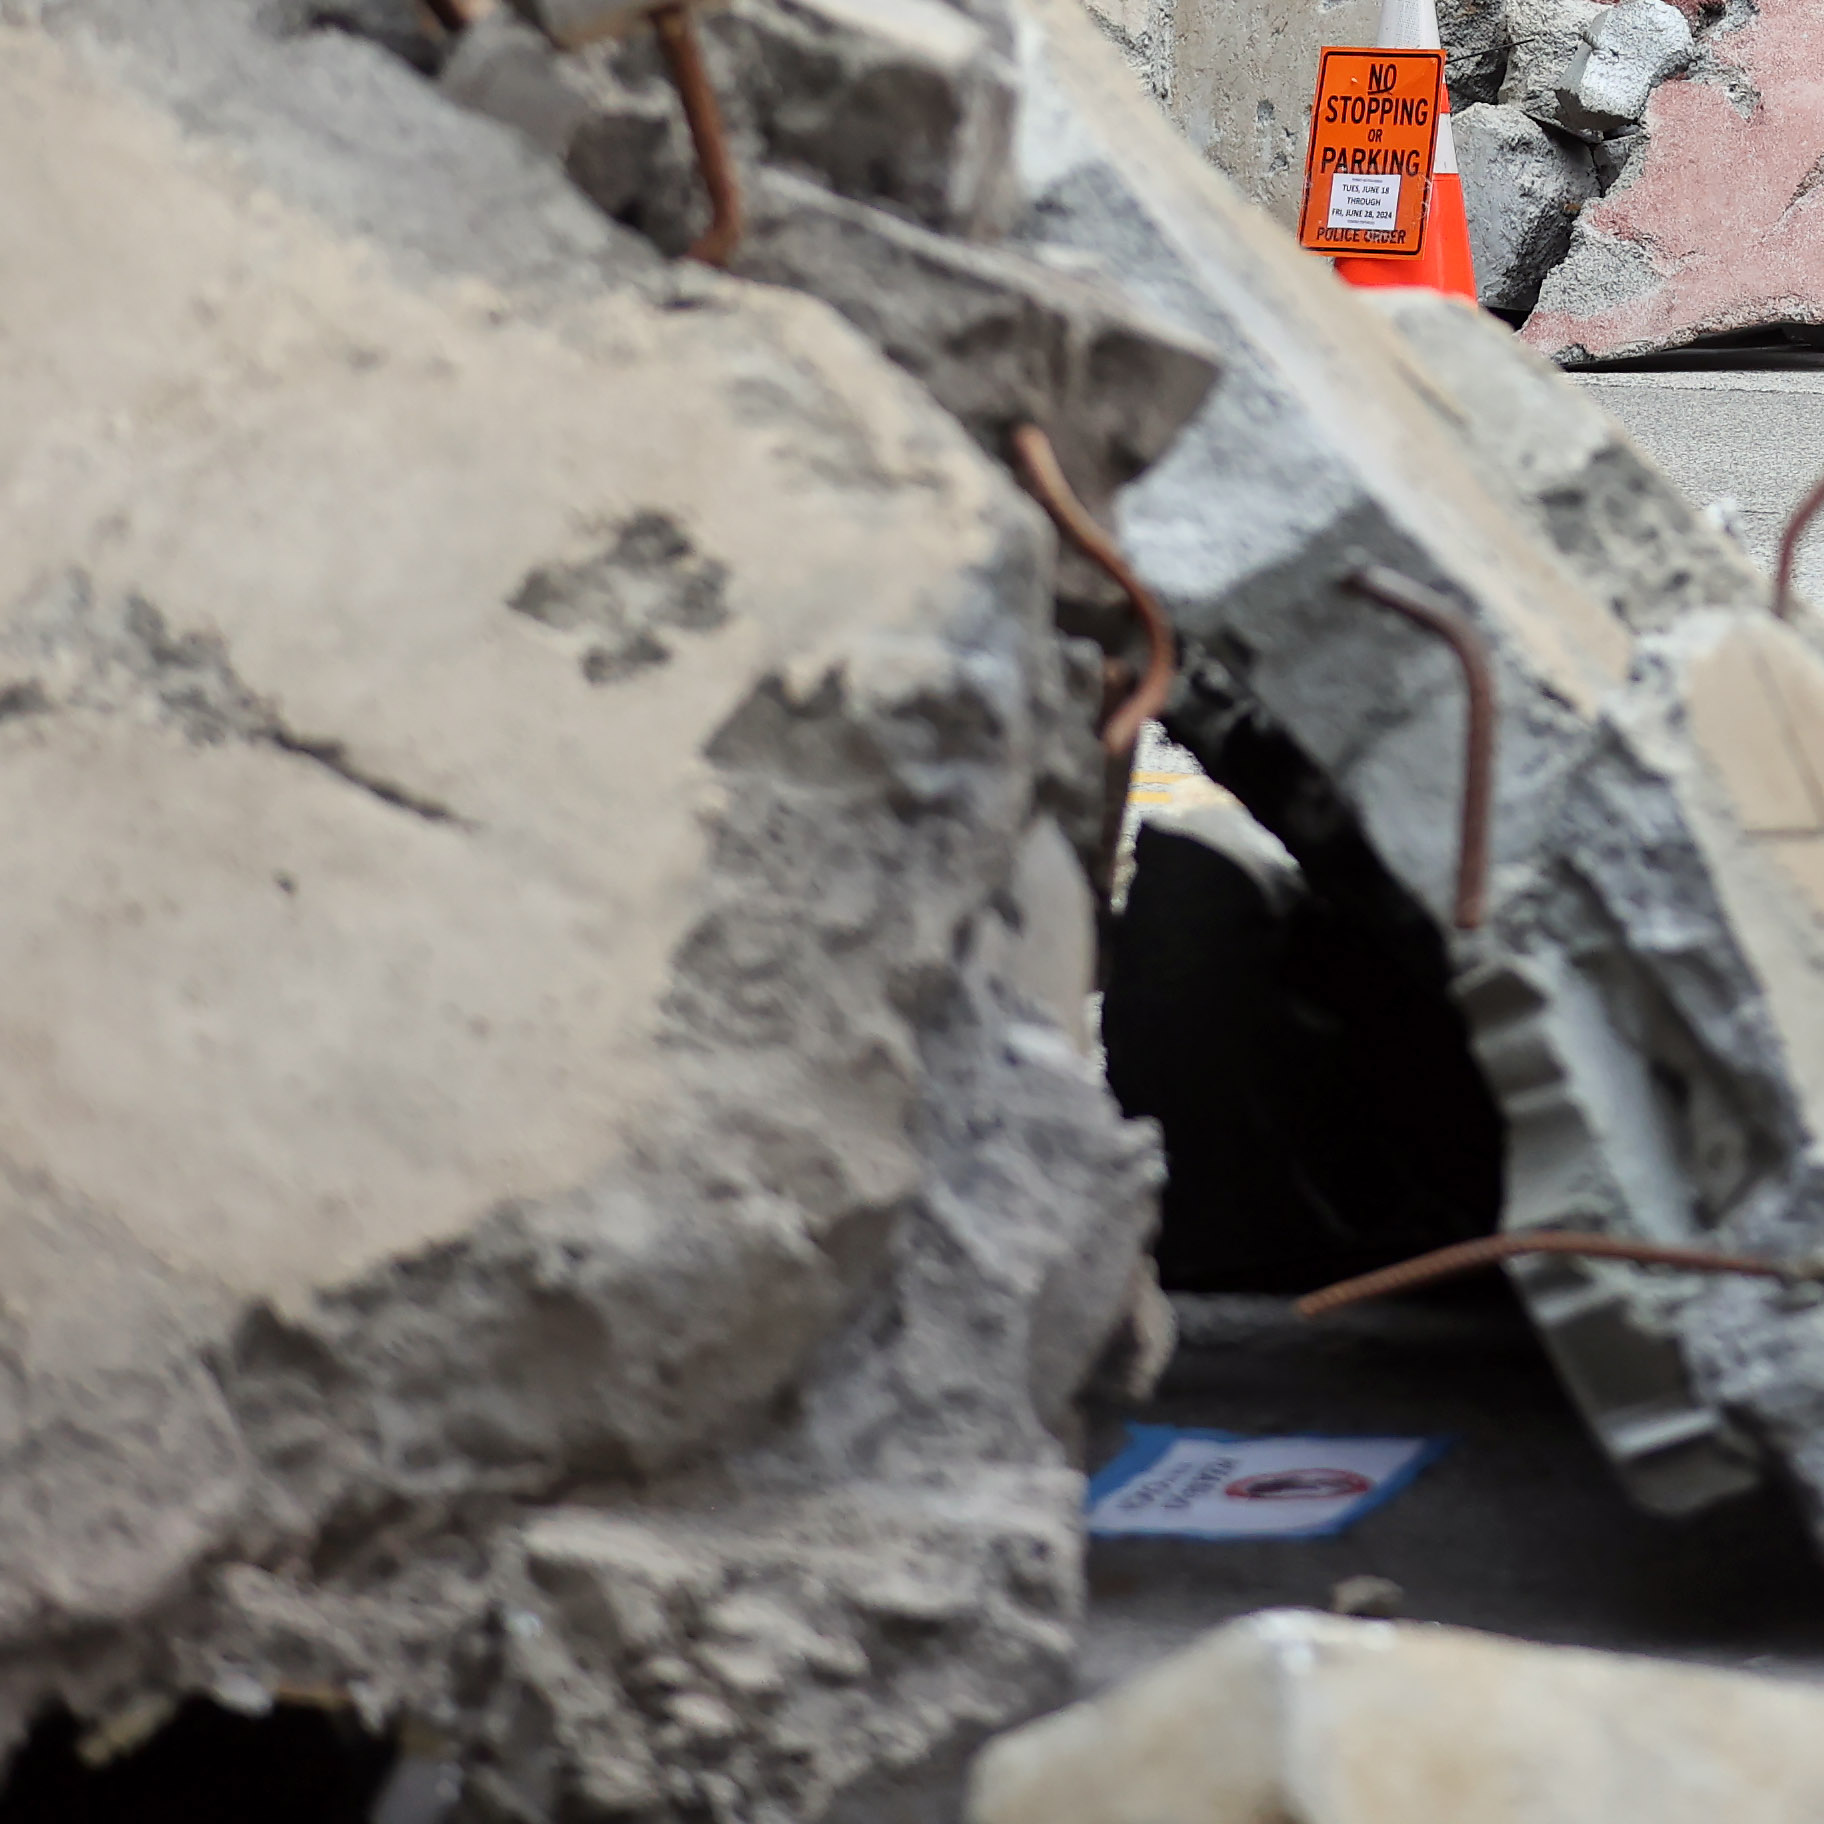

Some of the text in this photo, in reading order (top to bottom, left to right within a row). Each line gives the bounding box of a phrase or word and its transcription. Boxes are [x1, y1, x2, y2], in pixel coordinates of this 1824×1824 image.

[1368, 63, 1397, 91] NO
[1325, 94, 1428, 126] STOPPING
[1367, 128, 1383, 143] OR
[1320, 146, 1420, 177] PARKING
[1342, 183, 1390, 195] TUES, JUNE 18
[1346, 196, 1382, 207] THROUGH
[1345, 209, 1363, 218] JUNE
[1375, 211, 1392, 219] 2024
[1316, 226, 1406, 245] POLICE ORDER
